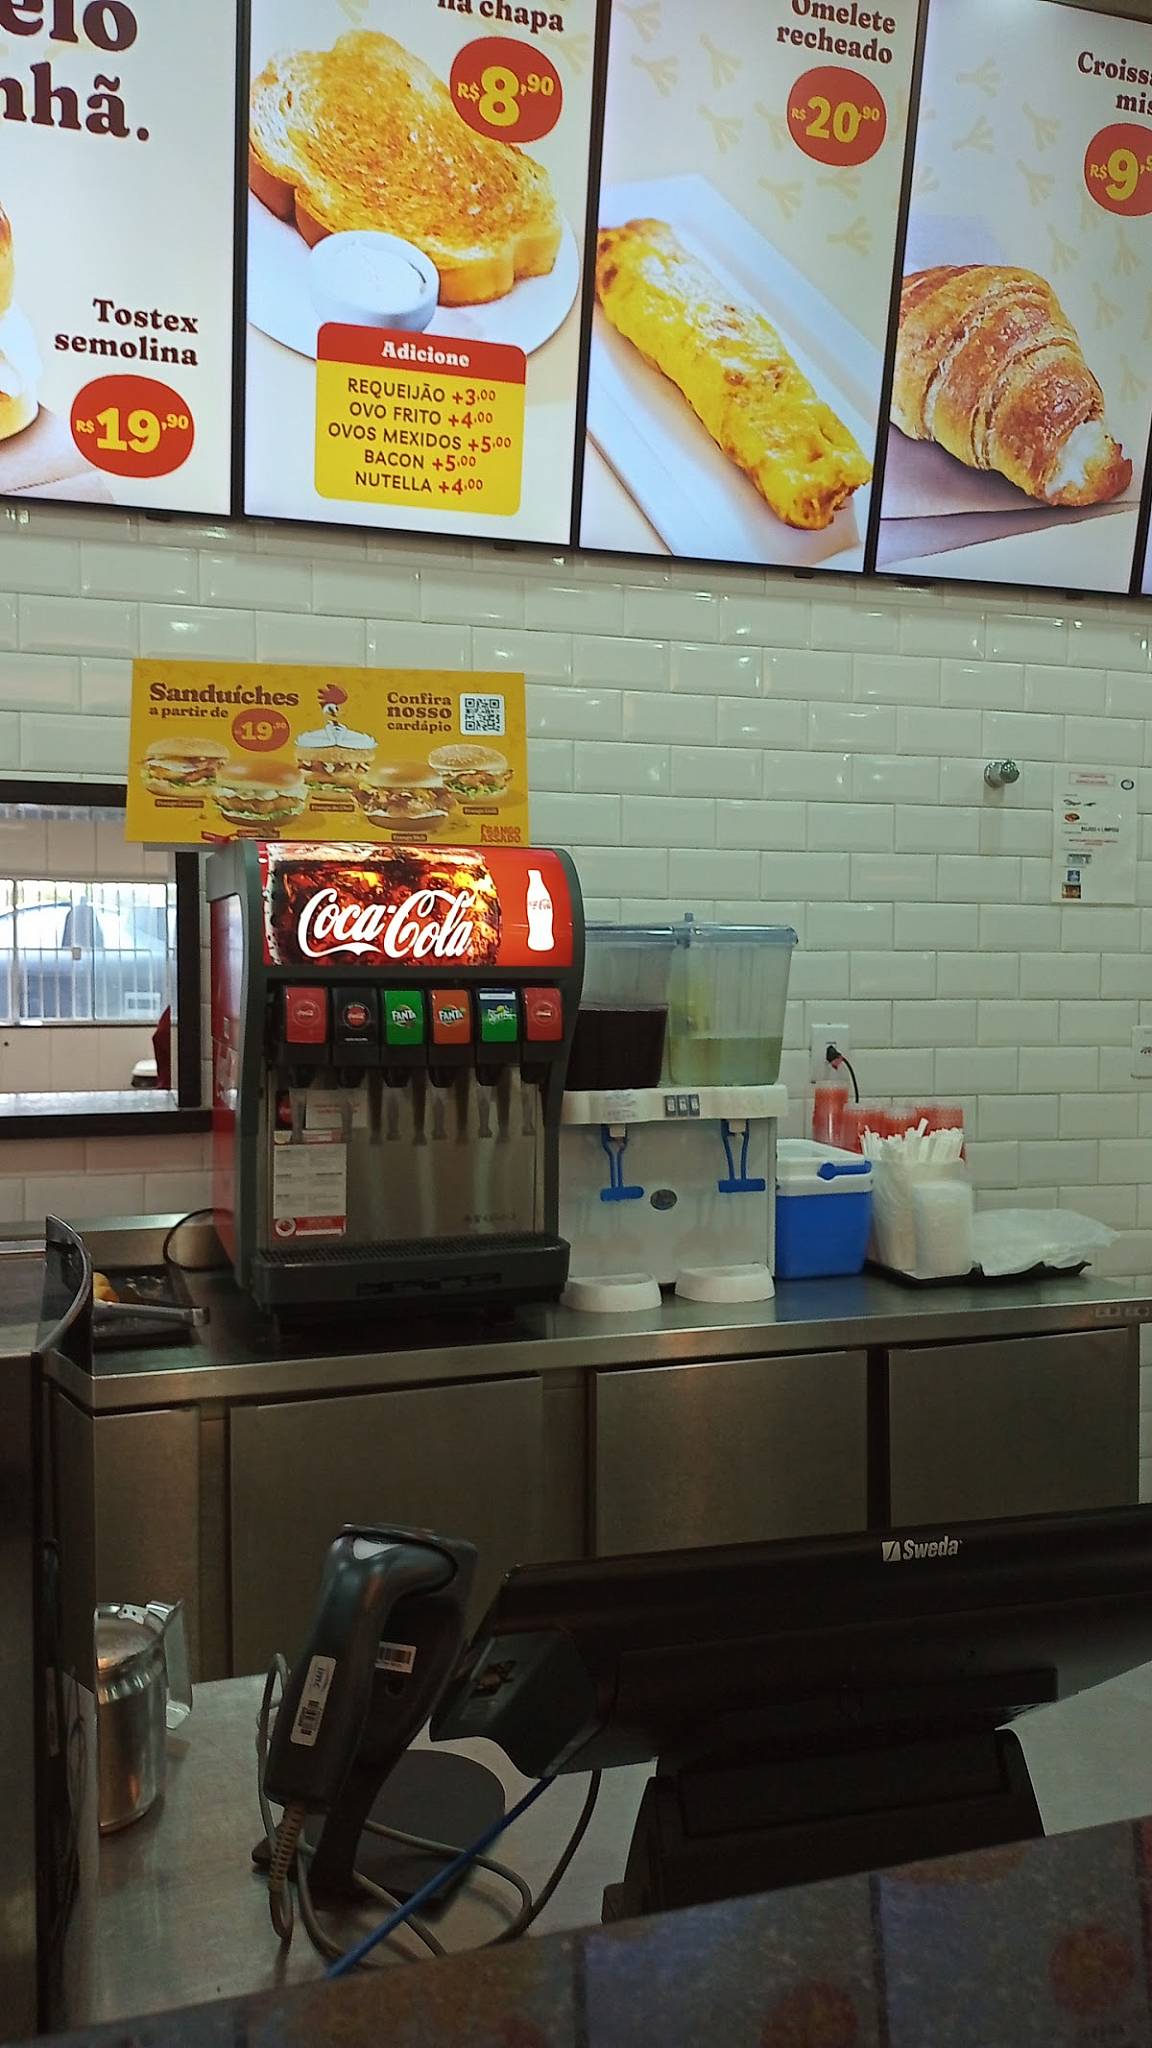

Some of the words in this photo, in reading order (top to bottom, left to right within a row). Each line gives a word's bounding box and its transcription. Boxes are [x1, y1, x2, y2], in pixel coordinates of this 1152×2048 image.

[479, 0, 564, 34] chapa
[791, 0, 896, 34] Omelete
[776, 25, 893, 64] recheado
[1077, 51, 1152, 86] Croiss
[92, 297, 199, 334] Tostex
[54, 333, 199, 366] semolina
[381, 340, 471, 368] Adicione
[347, 377, 446, 403] REQUEIJÃO
[349, 401, 387, 419] OVO
[393, 406, 442, 426] FRITO
[328, 422, 377, 441] OVOS
[383, 428, 462, 450] MEXIDOS
[364, 449, 424, 469] BACON
[355, 471, 433, 493] NUTELLA
[149, 682, 300, 707] Sanduíches
[387, 691, 452, 706] Confira
[149, 706, 159, 716] a
[161, 705, 208, 719] partir
[210, 706, 229, 718] de
[387, 706, 452, 719] nosso
[387, 720, 452, 735] cardápio
[297, 887, 475, 958] Coca-Cola
[902, 1535, 960, 1560] Sweda
